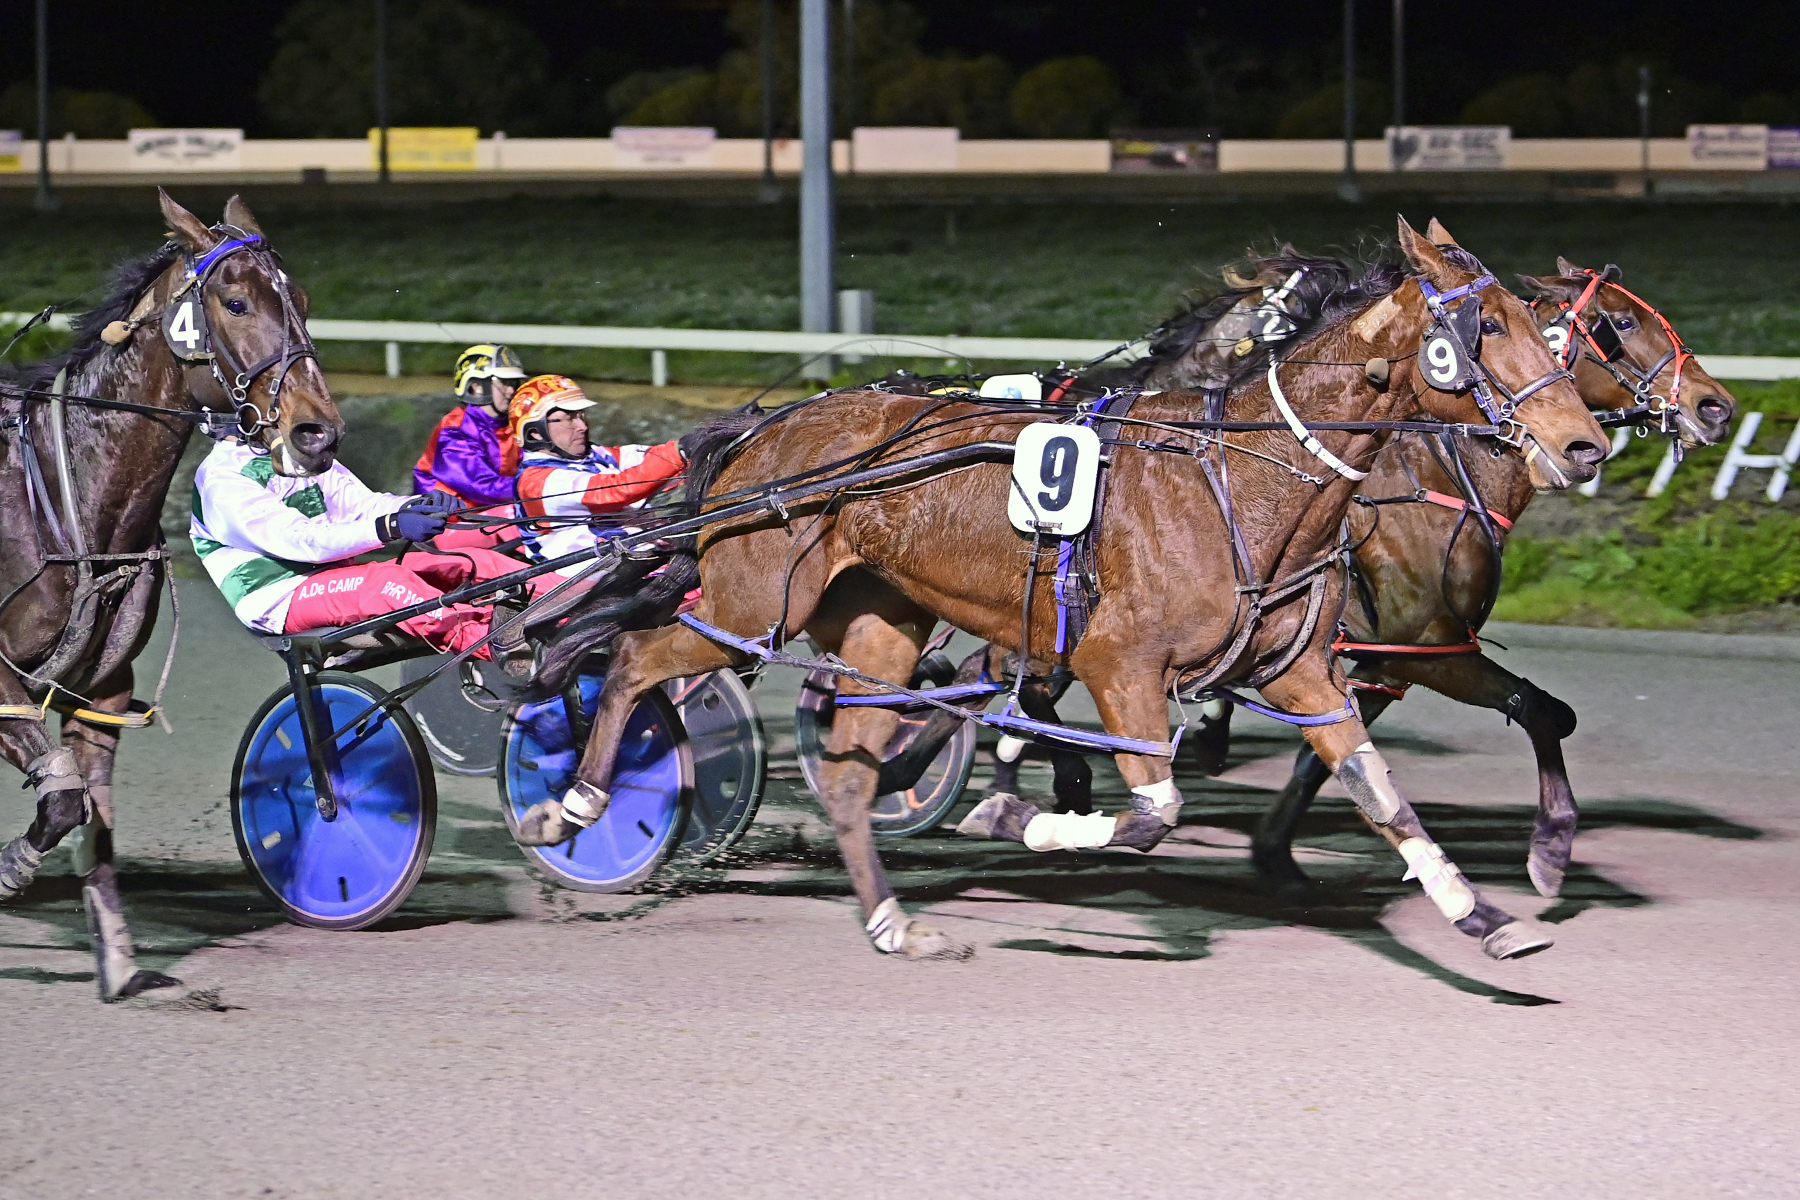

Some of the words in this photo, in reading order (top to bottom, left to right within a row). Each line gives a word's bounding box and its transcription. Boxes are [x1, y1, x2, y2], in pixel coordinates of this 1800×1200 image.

[169, 302, 200, 349] 4
[1257, 305, 1287, 342] 2
[1427, 338, 1458, 383] 9
[1038, 436, 1079, 512] 9
[328, 576, 364, 594] CAMP
